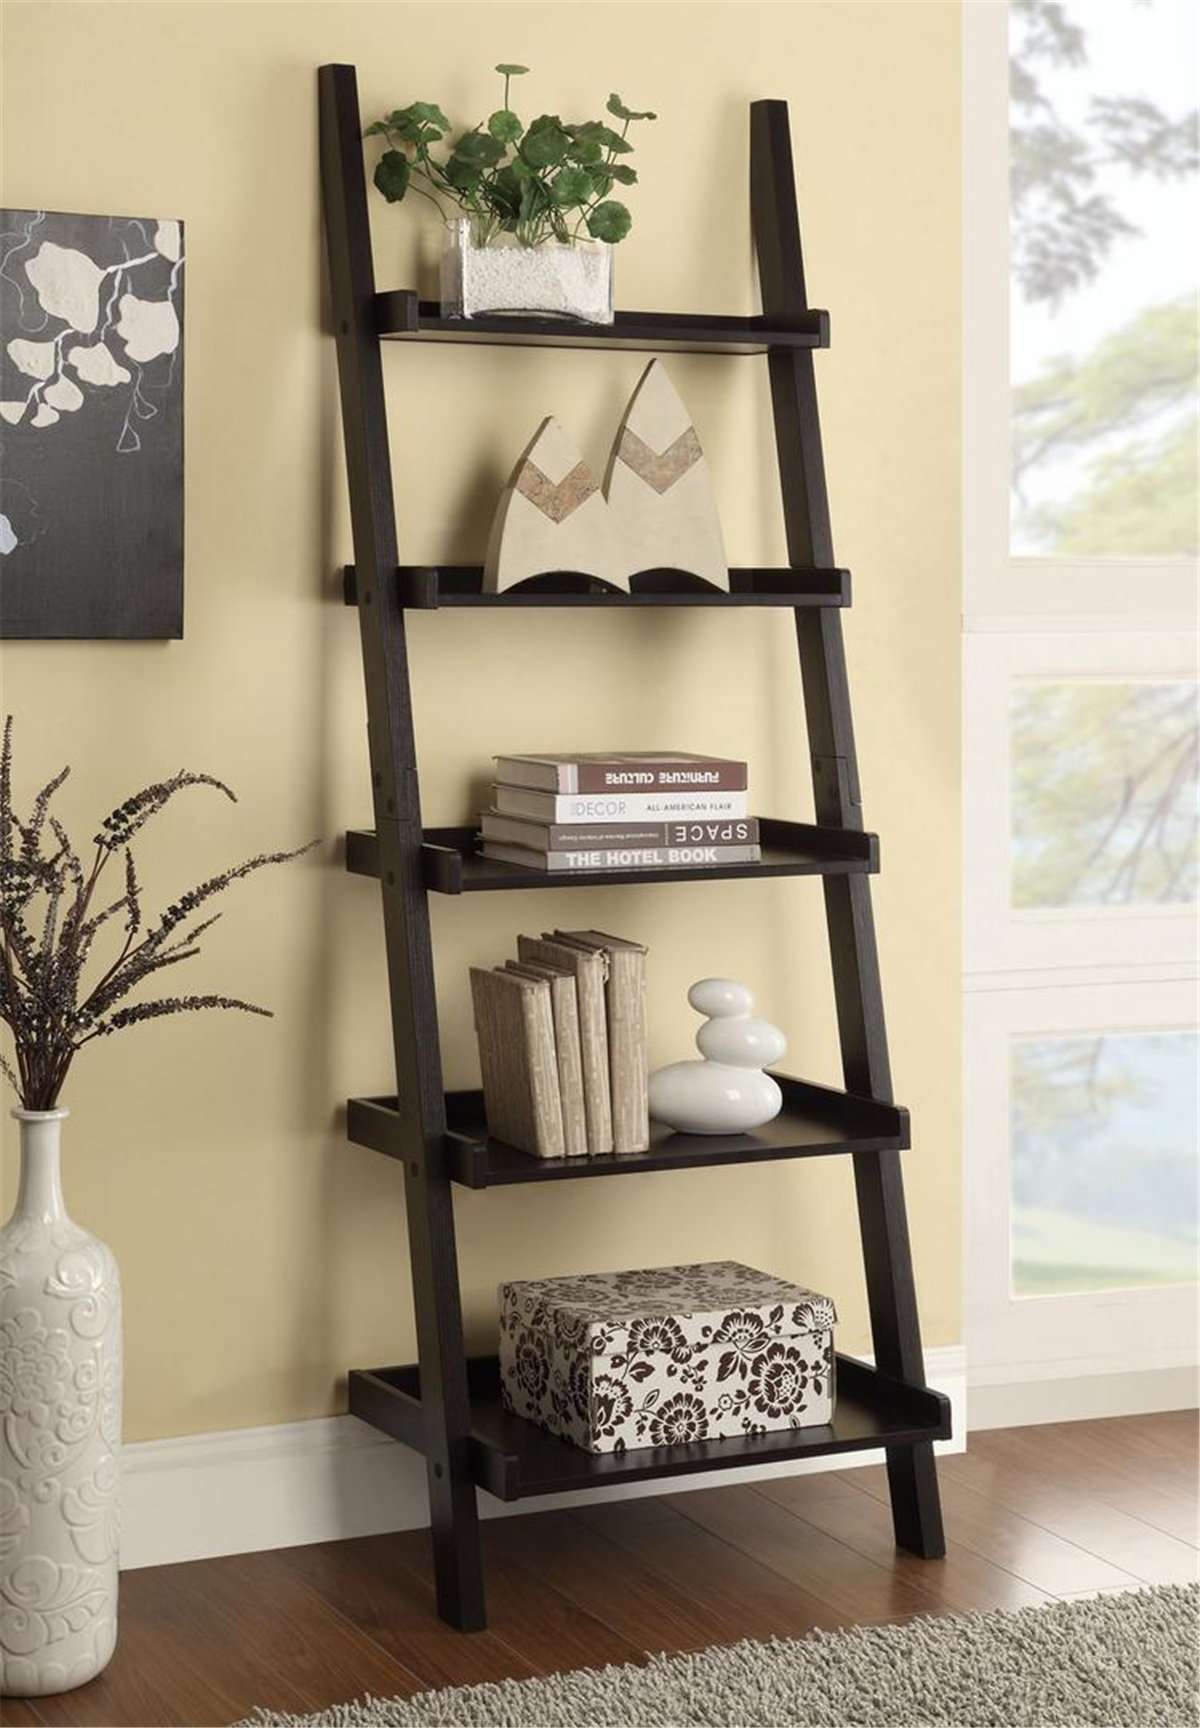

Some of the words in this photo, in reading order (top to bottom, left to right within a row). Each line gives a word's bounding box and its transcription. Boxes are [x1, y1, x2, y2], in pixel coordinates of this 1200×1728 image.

[605, 772, 655, 785] CULTURE
[659, 771, 720, 784] FURNITURE
[576, 801, 626, 816] DECOR
[709, 802, 733, 811] FLAIR
[675, 823, 748, 842] SPACE
[565, 853, 602, 867] THE
[606, 850, 663, 865] HOTEL
[668, 847, 718, 863] BOOK
